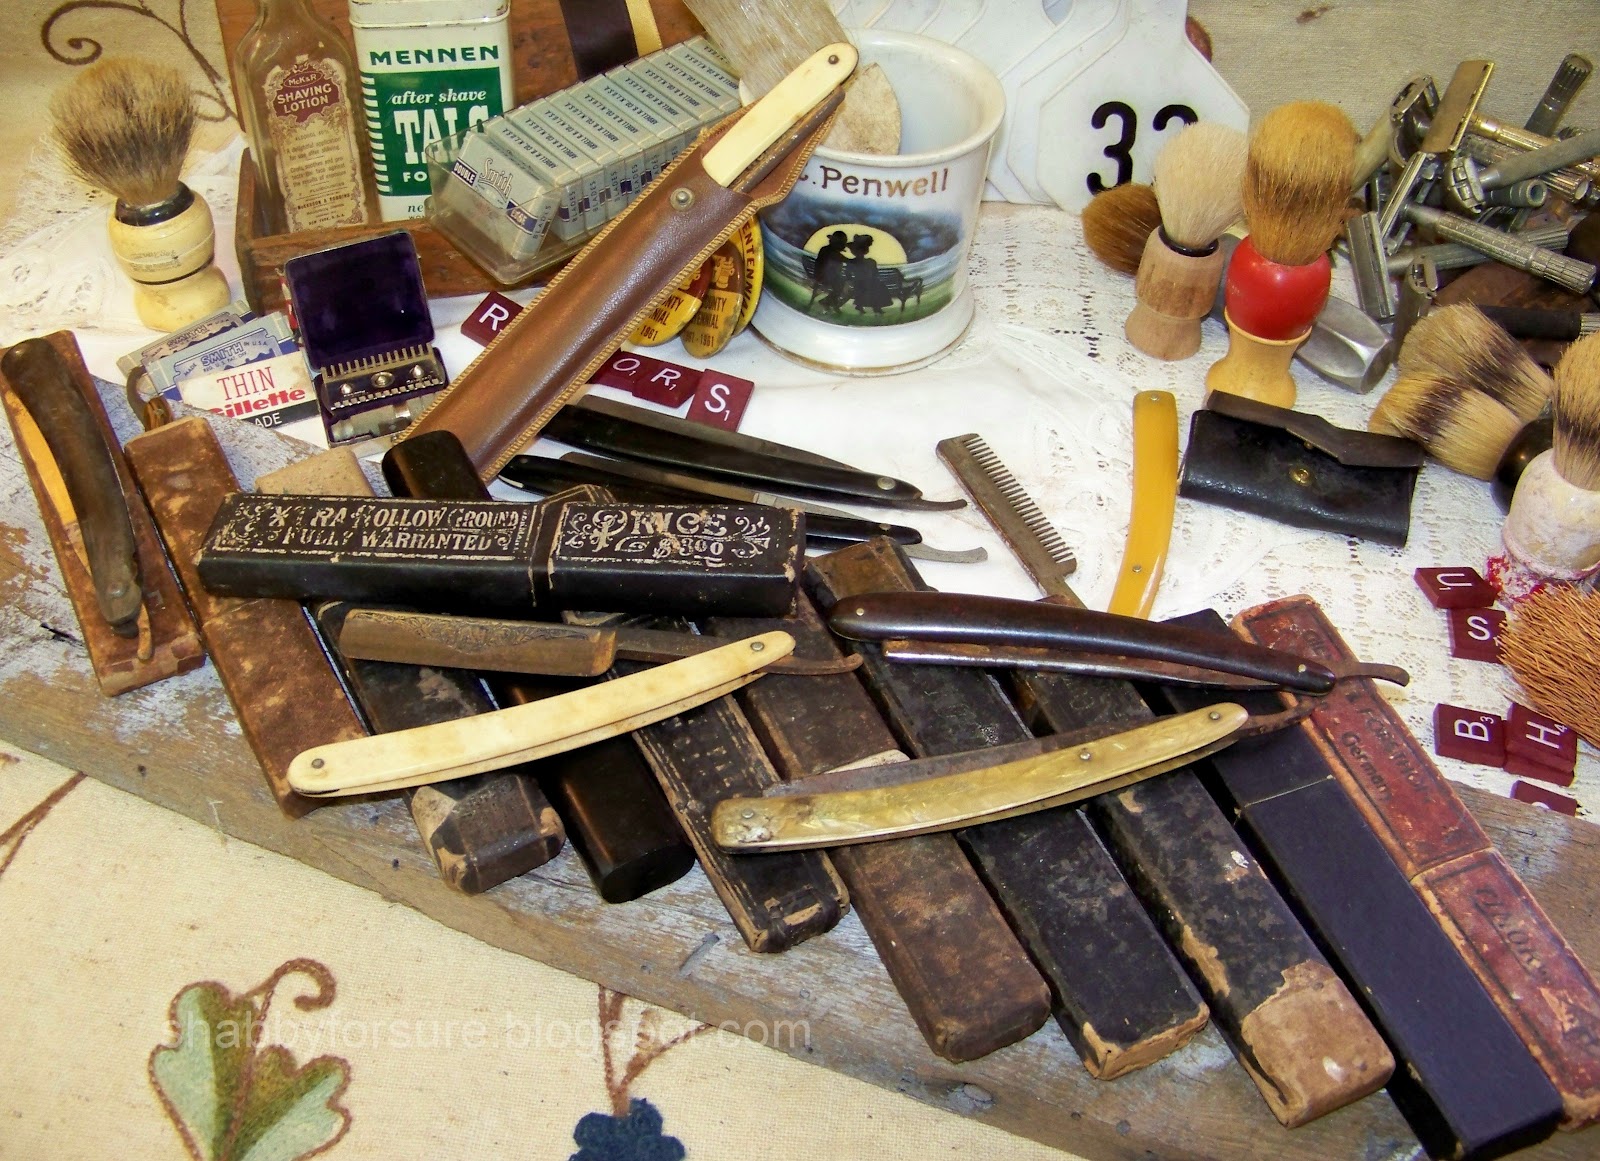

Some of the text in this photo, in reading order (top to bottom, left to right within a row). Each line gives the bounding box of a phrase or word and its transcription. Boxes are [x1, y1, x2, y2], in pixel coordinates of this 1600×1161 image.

[370, 45, 500, 66] MENNEN
[276, 83, 332, 104] SHAVING
[283, 94, 329, 114] LOTION
[391, 88, 487, 105] after shave
[453, 162, 477, 185] DOUBLE
[480, 158, 514, 200] Smith
[478, 302, 510, 332] R
[184, 362, 197, 376] MADE
[200, 342, 244, 367] SMITH
[216, 366, 275, 401] THIN
[255, 412, 282, 428] ADE
[362, 529, 492, 551] WARRANTED
